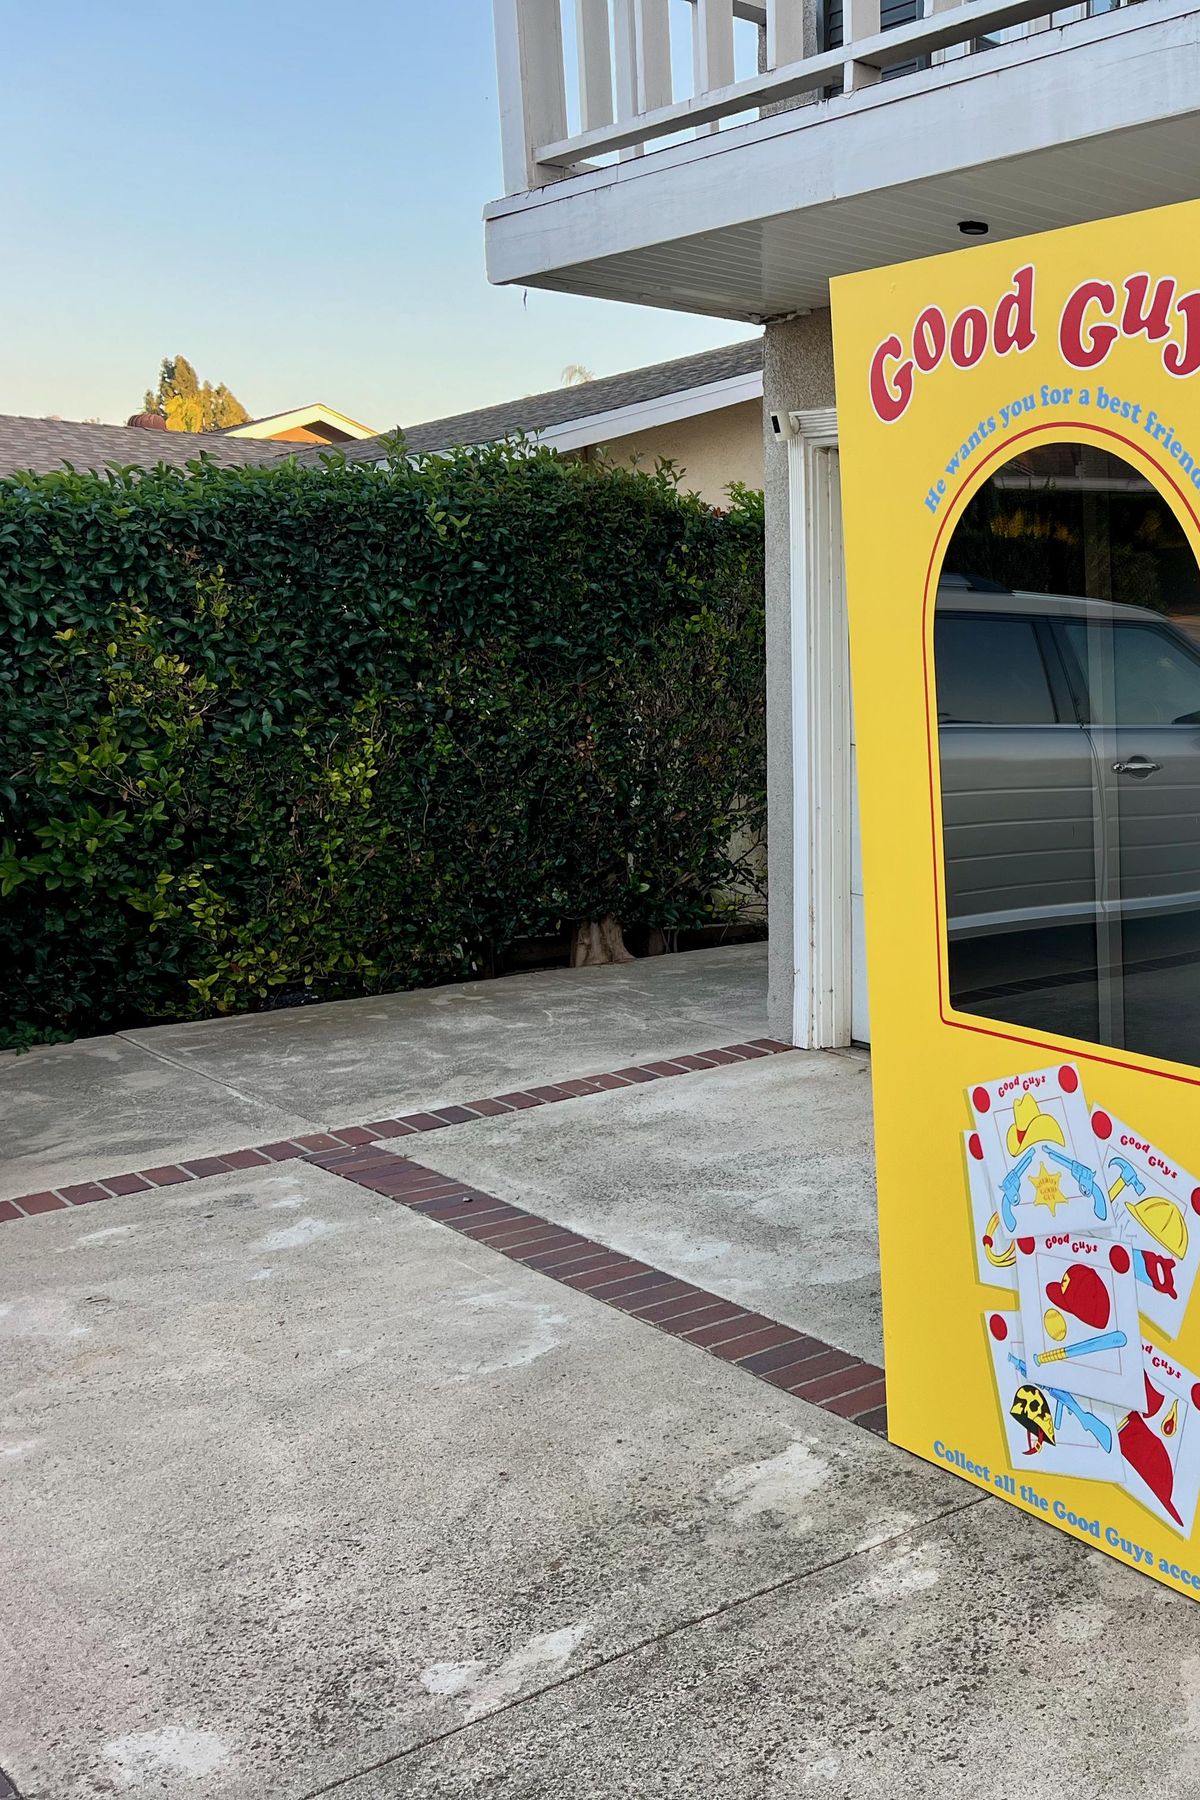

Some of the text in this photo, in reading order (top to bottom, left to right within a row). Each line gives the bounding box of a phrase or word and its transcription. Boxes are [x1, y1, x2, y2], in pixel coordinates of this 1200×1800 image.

[868, 264, 1036, 424] Good
[924, 478, 947, 514] He
[945, 414, 998, 476] wants
[999, 393, 1037, 428] you
[1041, 384, 1074, 407] for
[1078, 388, 1091, 406] a
[1096, 386, 1142, 425] best
[998, 1075, 1046, 1098] Good Guys
[1120, 1135, 1178, 1179] Good Guys
[1045, 1234, 1098, 1255] Good Guys
[1151, 1356, 1182, 1379] Guys
[933, 1440, 991, 1482] Collect
[994, 1474, 1016, 1496] all
[1020, 1485, 1049, 1512] the
[1052, 1500, 1100, 1538] Good
[1105, 1527, 1153, 1566] Guys
